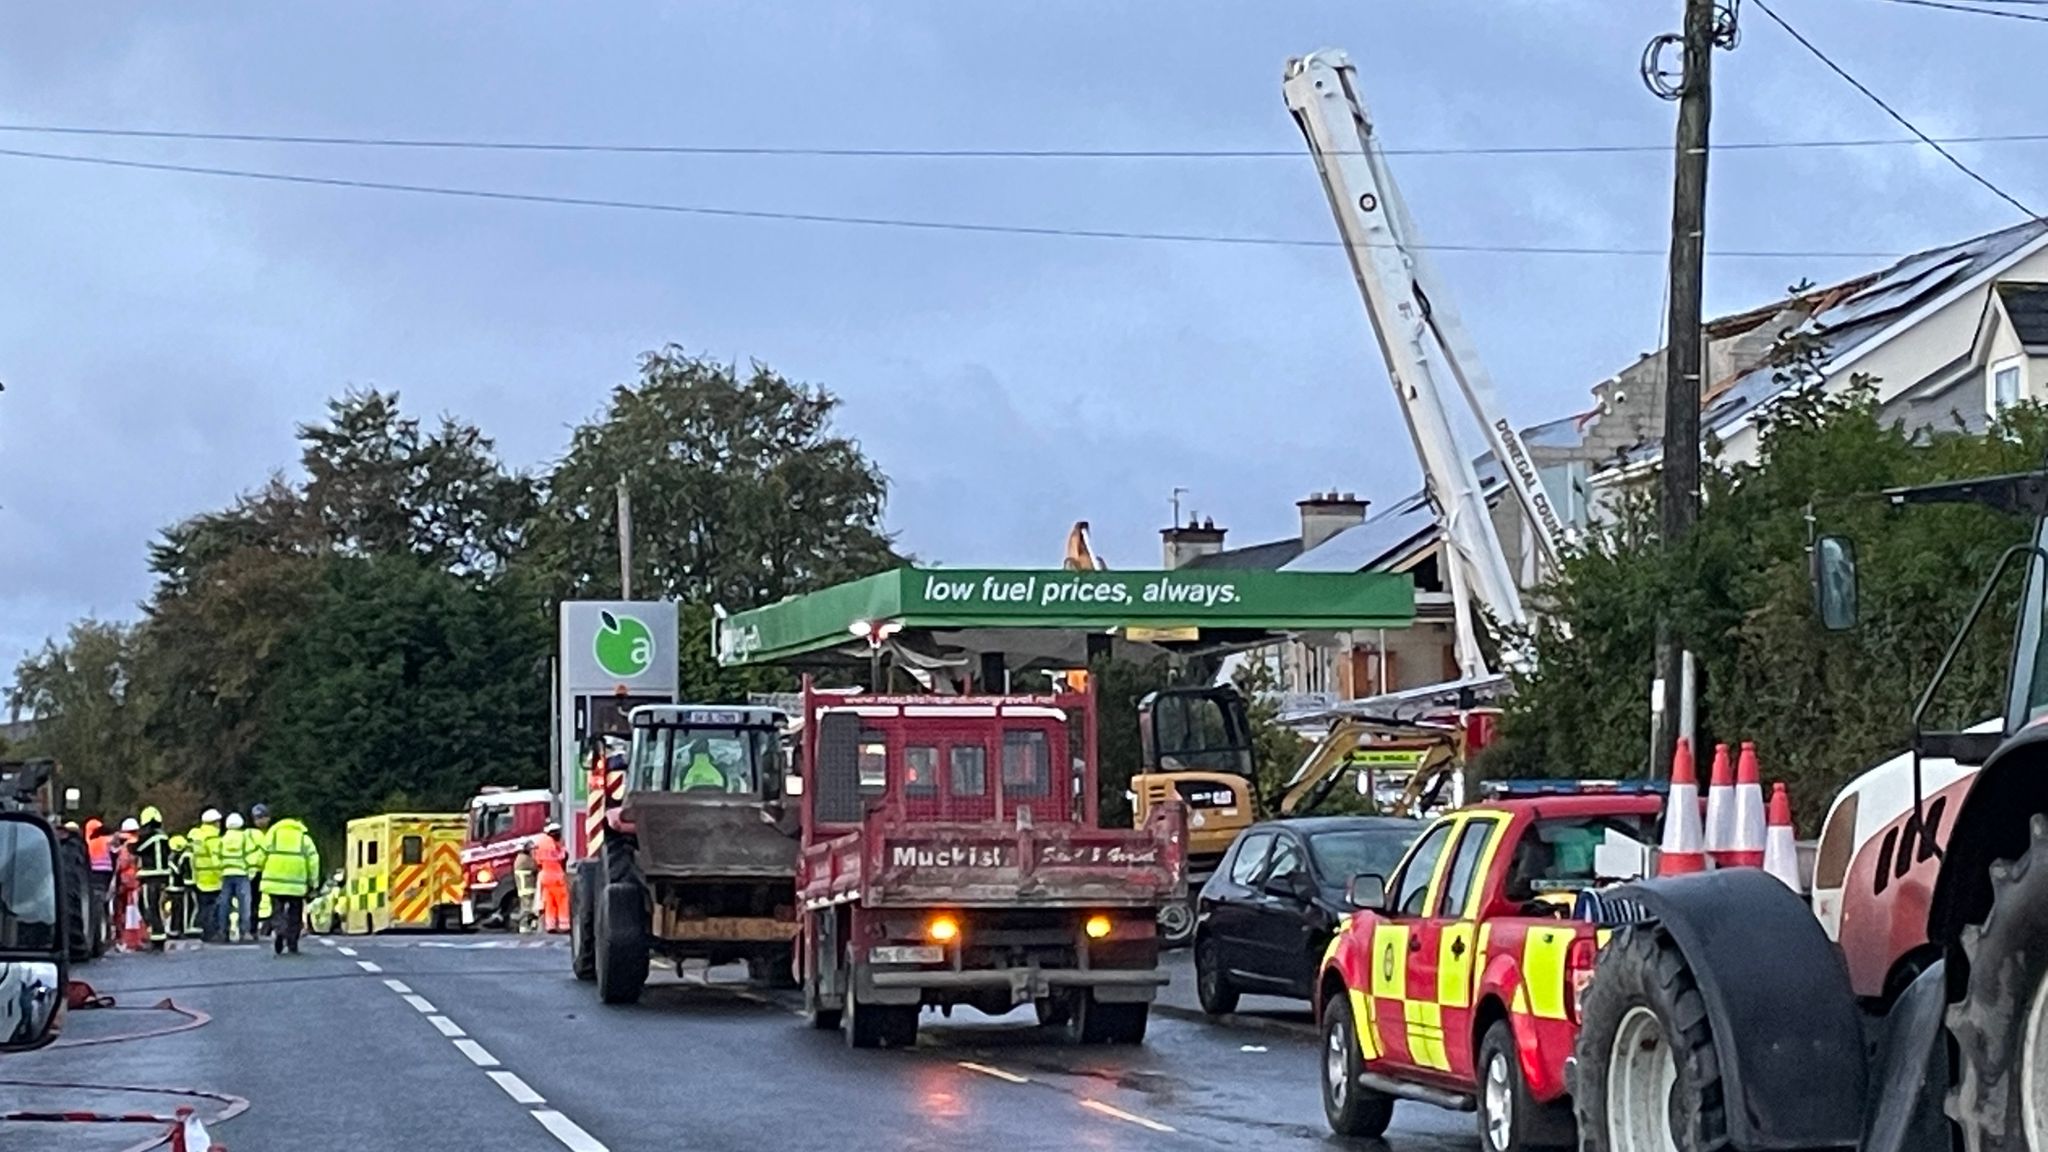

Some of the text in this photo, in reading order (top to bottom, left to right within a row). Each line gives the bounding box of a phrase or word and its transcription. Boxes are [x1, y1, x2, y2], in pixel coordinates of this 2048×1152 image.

[1495, 418, 1537, 494] DONEGAL
[924, 575, 1241, 607] low fuel prices, always.
